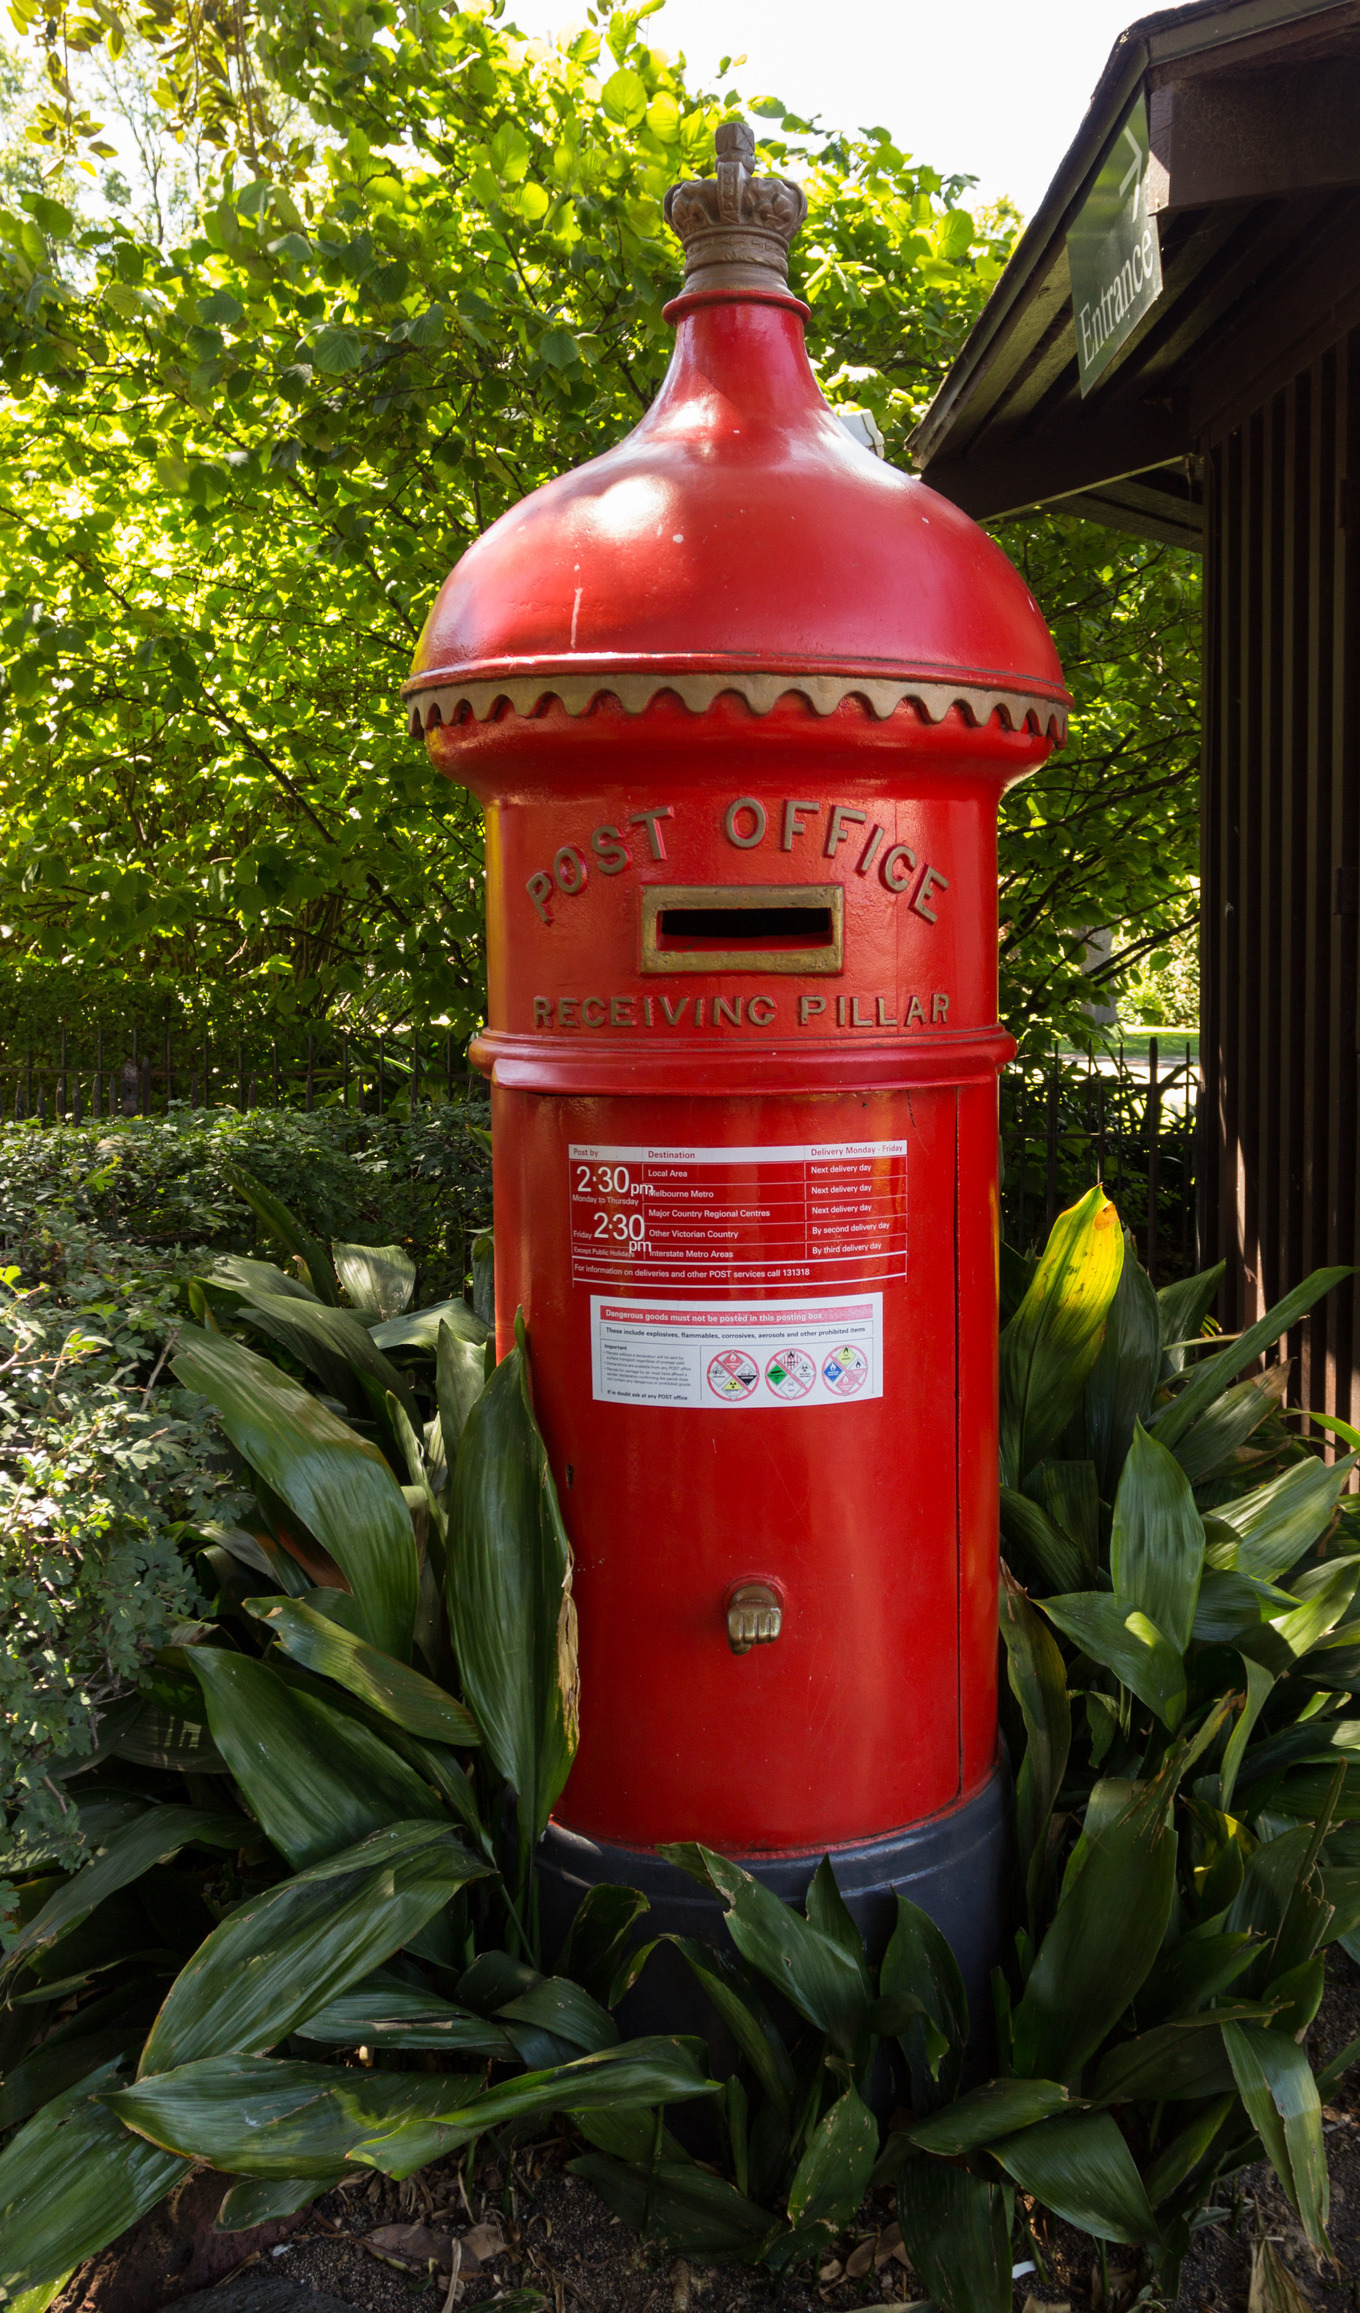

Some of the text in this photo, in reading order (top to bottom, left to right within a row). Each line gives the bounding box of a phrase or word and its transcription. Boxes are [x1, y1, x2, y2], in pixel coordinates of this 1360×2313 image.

[1079, 228, 1153, 370] Entrance
[525, 797, 950, 925] POST OFFICE
[533, 993, 950, 1028] RECEIVING PILLAR
[573, 1148, 598, 1157] Post by
[648, 1151, 695, 1159] Destination
[811, 1148, 843, 1158] Delivery
[846, 1147, 875, 1156] Monday
[882, 1145, 903, 1153] Friday
[648, 1169, 688, 1178] Local Area
[811, 1163, 872, 1174] Next delivery day
[648, 1189, 714, 1198] Melbourne Metro
[811, 1184, 872, 1194] Next delivery day
[572, 1194, 597, 1204] Monday
[607, 1197, 639, 1206] Thursday
[831, 1204, 858, 1213] delivery
[859, 1203, 872, 1212] day
[649, 1209, 670, 1218] Major
[672, 1210, 701, 1219] Country
[704, 1209, 738, 1218] Regional
[812, 1221, 890, 1235] By second delivery day
[573, 1230, 592, 1240] Friday
[649, 1229, 738, 1239] Other Victorian Country
[573, 1246, 591, 1255] Except
[592, 1248, 609, 1256] Public
[812, 1242, 882, 1255] By third delivery day
[649, 1250, 733, 1258] Interstate Metro Areas
[586, 1265, 622, 1275] information
[634, 1269, 669, 1278] deliveries
[733, 1270, 765, 1278] services
[767, 1269, 781, 1277] call
[605, 1309, 644, 1320] Dangerous
[645, 1313, 669, 1321] goods
[719, 1314, 748, 1323] posted
[759, 1313, 775, 1321] this
[776, 1313, 807, 1322] posting
[818, 1328, 849, 1337] prohibited
